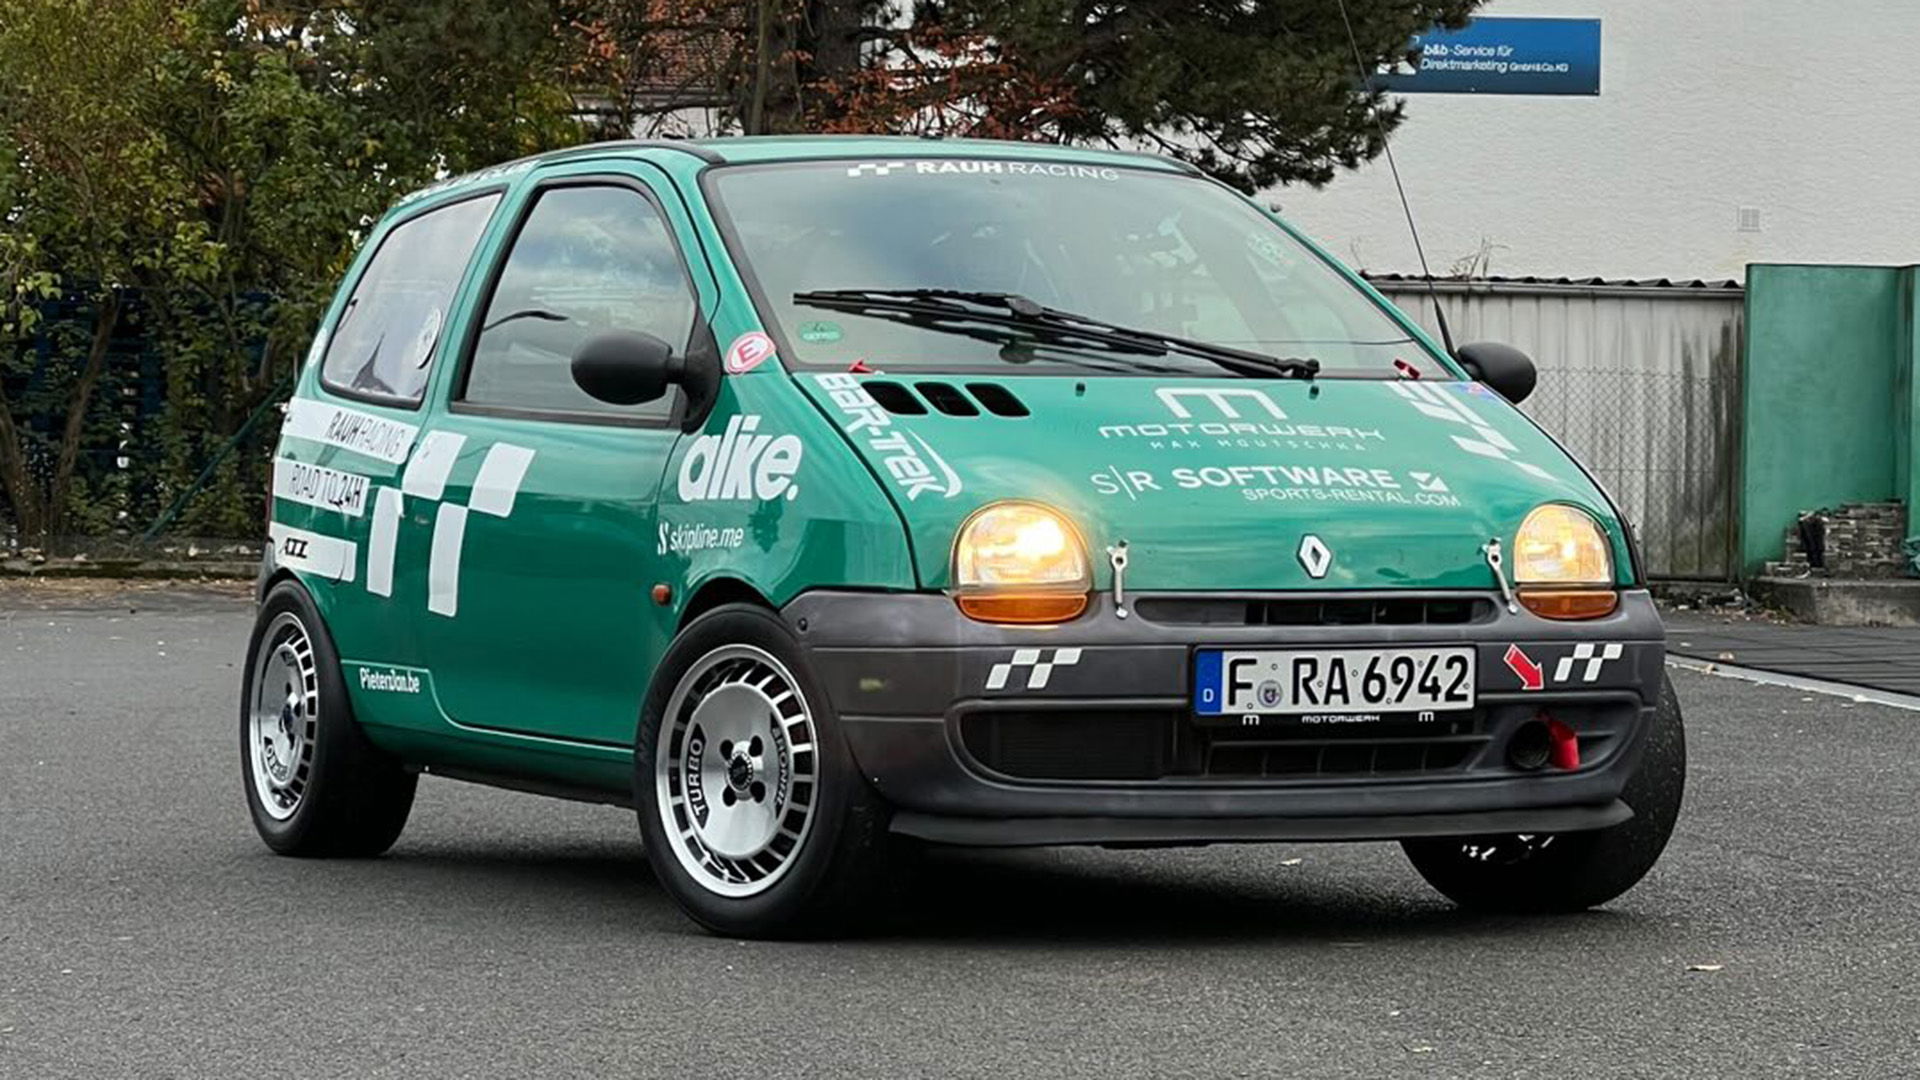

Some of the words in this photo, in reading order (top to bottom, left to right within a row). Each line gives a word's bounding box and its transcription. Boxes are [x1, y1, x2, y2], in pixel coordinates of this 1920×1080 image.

[1420, 58, 1508, 73] Direktmarketing
[737, 338, 759, 365] E
[1098, 422, 1386, 441] MOTORWERK
[678, 415, 802, 501] alike.
[290, 463, 321, 499] ROAD
[1172, 466, 1402, 490] SOFTWARE
[1243, 487, 1462, 509] SPORTS-RENTAL.COM
[670, 522, 744, 556] skipline.me
[1228, 658, 1257, 706] F
[1202, 688, 1214, 703] D
[1301, 714, 1380, 725] MOTORWERK
[687, 738, 707, 817] TURBO
